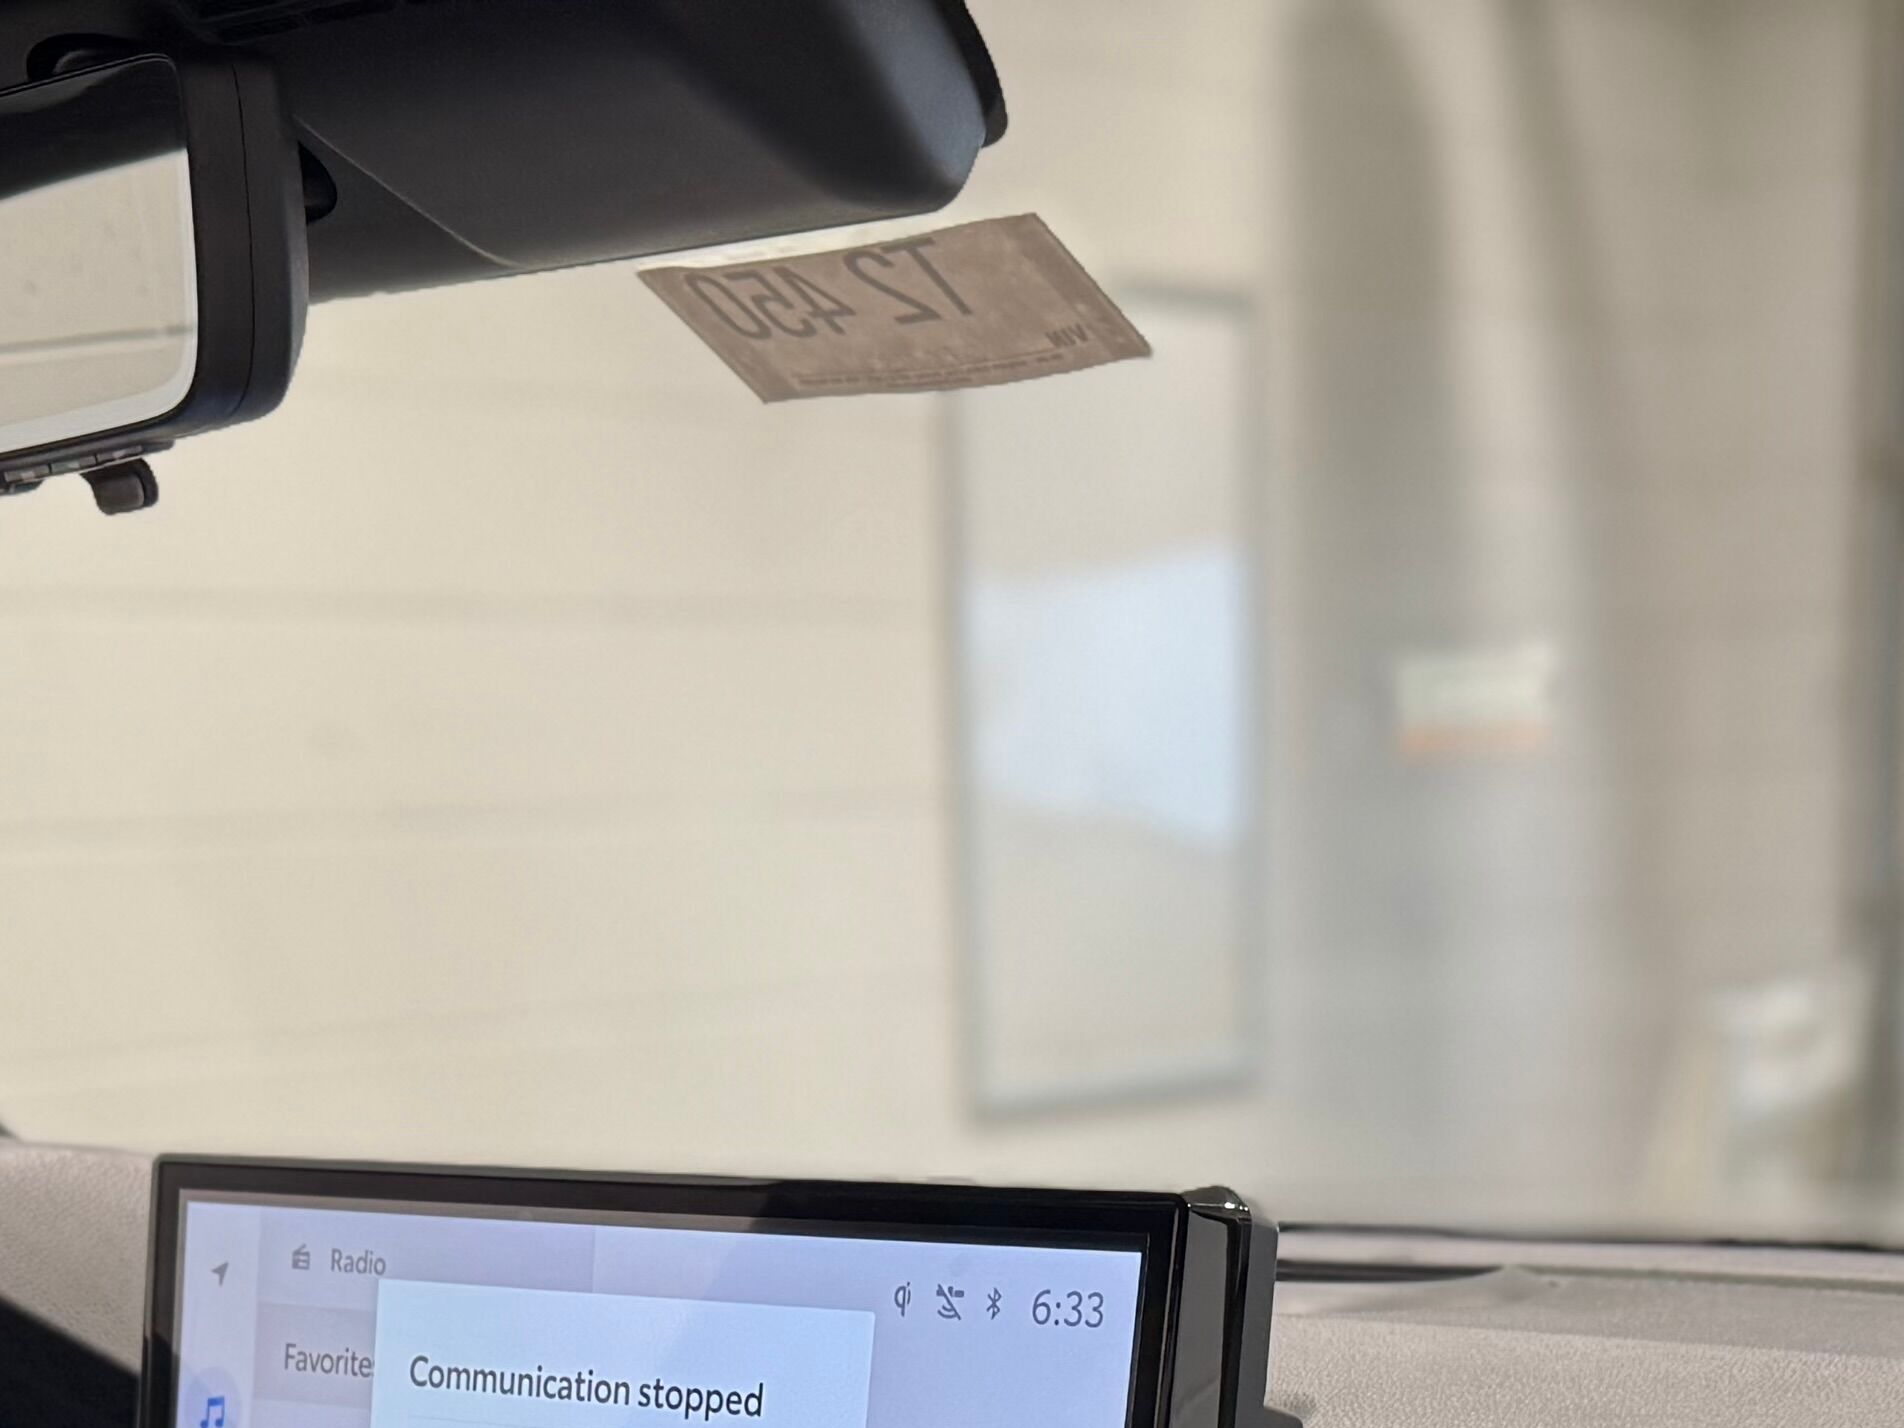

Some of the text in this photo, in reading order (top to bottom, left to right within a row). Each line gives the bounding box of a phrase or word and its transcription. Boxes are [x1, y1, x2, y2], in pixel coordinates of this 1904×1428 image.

[330, 1248, 386, 1276] Radio
[1032, 1289, 1105, 1328] 6:33
[284, 1342, 375, 1378] Favorite
[409, 1355, 764, 1421] Communication stopped
